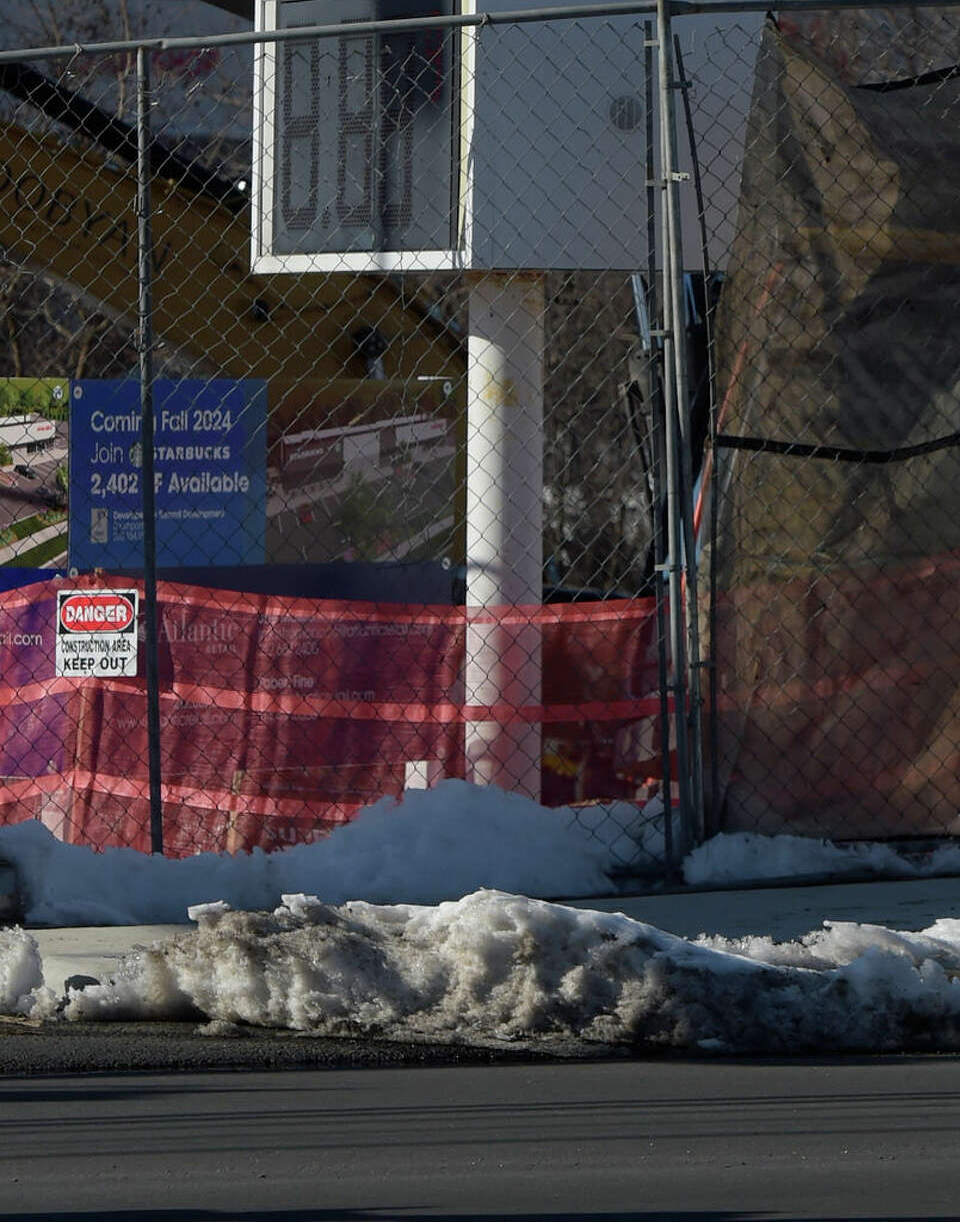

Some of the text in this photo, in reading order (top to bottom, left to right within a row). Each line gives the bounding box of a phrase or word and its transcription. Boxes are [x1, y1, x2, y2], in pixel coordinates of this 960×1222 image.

[162, 410, 188, 433] Fall
[193, 409, 233, 432] 2024
[90, 442, 124, 464] Join
[90, 473, 139, 498] 2,402
[168, 471, 249, 493] Available
[65, 604, 128, 623] DANGER
[61, 639, 131, 653] CONSTRUCTION AREA
[63, 656, 128, 670] KEEP OUT
